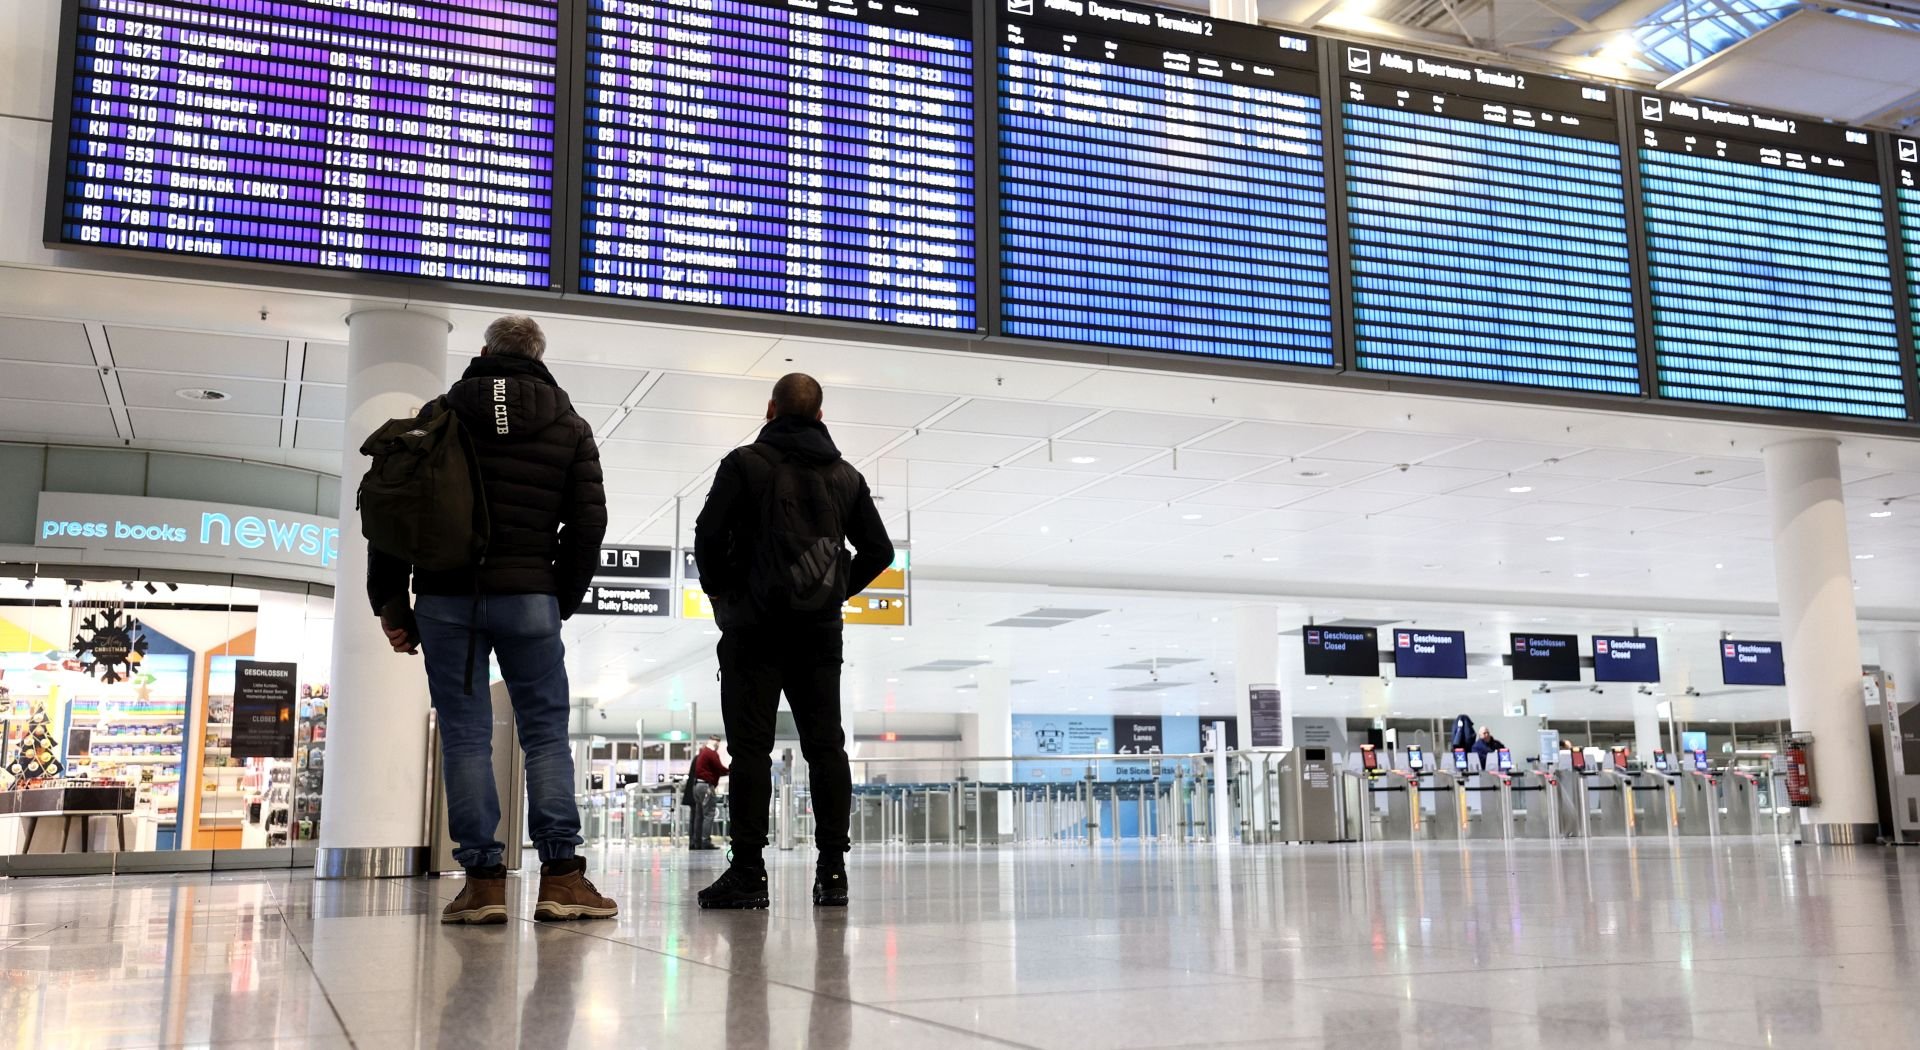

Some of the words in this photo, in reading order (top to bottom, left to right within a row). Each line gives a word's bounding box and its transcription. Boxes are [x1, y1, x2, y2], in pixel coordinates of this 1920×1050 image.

[603, 0, 617, 13] TP
[625, 2, 654, 19] 3343
[668, 9, 711, 28] Lisbon
[1088, 1, 1150, 26] Departures
[1154, 13, 1202, 35] Terminal
[1204, 22, 1213, 36] 2
[602, 16, 617, 31] UA
[632, 21, 653, 37] 761
[668, 27, 711, 46] Denver
[125, 21, 162, 40] 9732
[180, 29, 269, 55] Luxembourg
[381, 58, 421, 77] 13:45
[461, 70, 532, 93] Lufthansa
[601, 35, 616, 49] TP
[631, 39, 653, 55] 555
[668, 45, 710, 64] Lisbon
[123, 42, 161, 60] 4675
[178, 49, 224, 69] Zadar
[330, 71, 370, 89] 10:10
[460, 92, 531, 112] cancelled
[601, 53, 616, 68] A3
[667, 63, 710, 82] Athens
[1417, 58, 1471, 81] Departures
[1474, 68, 1516, 88] Terminal
[1517, 75, 1525, 90] 2
[122, 62, 159, 81] 4437
[177, 70, 232, 91] Zagreb
[329, 90, 369, 109] 10:35
[427, 104, 451, 120] K05
[459, 111, 530, 131] cancelled
[600, 71, 615, 86] KM
[667, 81, 703, 99] Malta
[130, 84, 158, 101] 327
[176, 90, 257, 114] Singapore
[328, 110, 368, 129] 12:05
[426, 123, 451, 139] H32
[459, 128, 514, 148] 446-451
[629, 112, 651, 128] 224
[90, 100, 110, 116] LH
[128, 105, 156, 122] 410
[174, 111, 202, 128] New
[211, 115, 247, 133] York
[255, 121, 299, 140] (JFK)
[326, 130, 368, 148] 12:20
[425, 143, 450, 159] L21
[458, 147, 529, 169] Lufthansa
[599, 127, 614, 141] OS
[630, 131, 651, 146] 116
[665, 136, 709, 154] Vienna
[89, 121, 108, 137] KM
[127, 125, 155, 143] 307
[173, 131, 219, 150] Malta
[325, 150, 367, 168] 12:25
[376, 156, 416, 174] 14:20
[457, 166, 528, 188] Lufthansa
[598, 145, 613, 160] LH
[628, 149, 650, 165] 574
[665, 154, 694, 171] Cape
[702, 159, 730, 175] Town
[87, 142, 107, 158] TP
[125, 146, 154, 163] 553
[172, 152, 226, 172] Lisbon
[324, 170, 366, 188] 12:50
[456, 186, 528, 207] Lufthansa
[628, 168, 650, 184] 354
[124, 167, 152, 184] 925
[170, 172, 234, 193] Bangkok
[243, 181, 287, 199] (BKK)
[323, 190, 365, 208] 13:35
[455, 205, 511, 224] 309-314
[597, 183, 612, 198] LH
[664, 191, 708, 209] London
[715, 198, 751, 215] (LHR)
[113, 187, 151, 205] 4439
[169, 193, 215, 212] Split
[322, 210, 364, 228] 13:55
[455, 228, 527, 246] cancelled
[596, 221, 611, 236] A3
[664, 210, 736, 231] Luxembourg
[83, 205, 102, 221] MS
[167, 214, 213, 233] Cairo
[321, 230, 363, 248] 14:10
[454, 244, 526, 265] Lufthansa
[595, 240, 610, 255] SK
[81, 227, 101, 243] OS
[121, 231, 148, 247] 104
[166, 235, 221, 255] Vienna
[320, 251, 362, 268] 15:40
[420, 261, 445, 276] K05
[453, 264, 525, 284] Lufthansa
[594, 259, 610, 274] LX
[619, 262, 648, 278] 1111
[662, 267, 707, 284] Zurich
[594, 279, 609, 293] SN
[662, 286, 721, 305] Brussels
[493, 378, 506, 402] POLO
[494, 404, 509, 435] CLUB
[43, 520, 108, 539] press
[114, 520, 188, 543] books
[200, 511, 339, 566] newsp
[597, 600, 622, 612] Bulky
[622, 601, 659, 614] Baggage
[1323, 630, 1364, 641] Geschlossen
[1324, 642, 1347, 651] Closed
[1413, 633, 1453, 644] Geschlossen
[1414, 644, 1436, 654] Closed
[1529, 638, 1566, 648] Geschlossen
[1611, 639, 1646, 650] Geschlossen
[1530, 648, 1550, 657] Closed
[1611, 650, 1631, 660] Closed
[1737, 644, 1772, 655] Geschlossen
[1739, 654, 1758, 663] Closed
[244, 668, 289, 677] GESCHLOSSEN
[252, 715, 277, 723] CLOSED
[1133, 724, 1156, 732] Spuren
